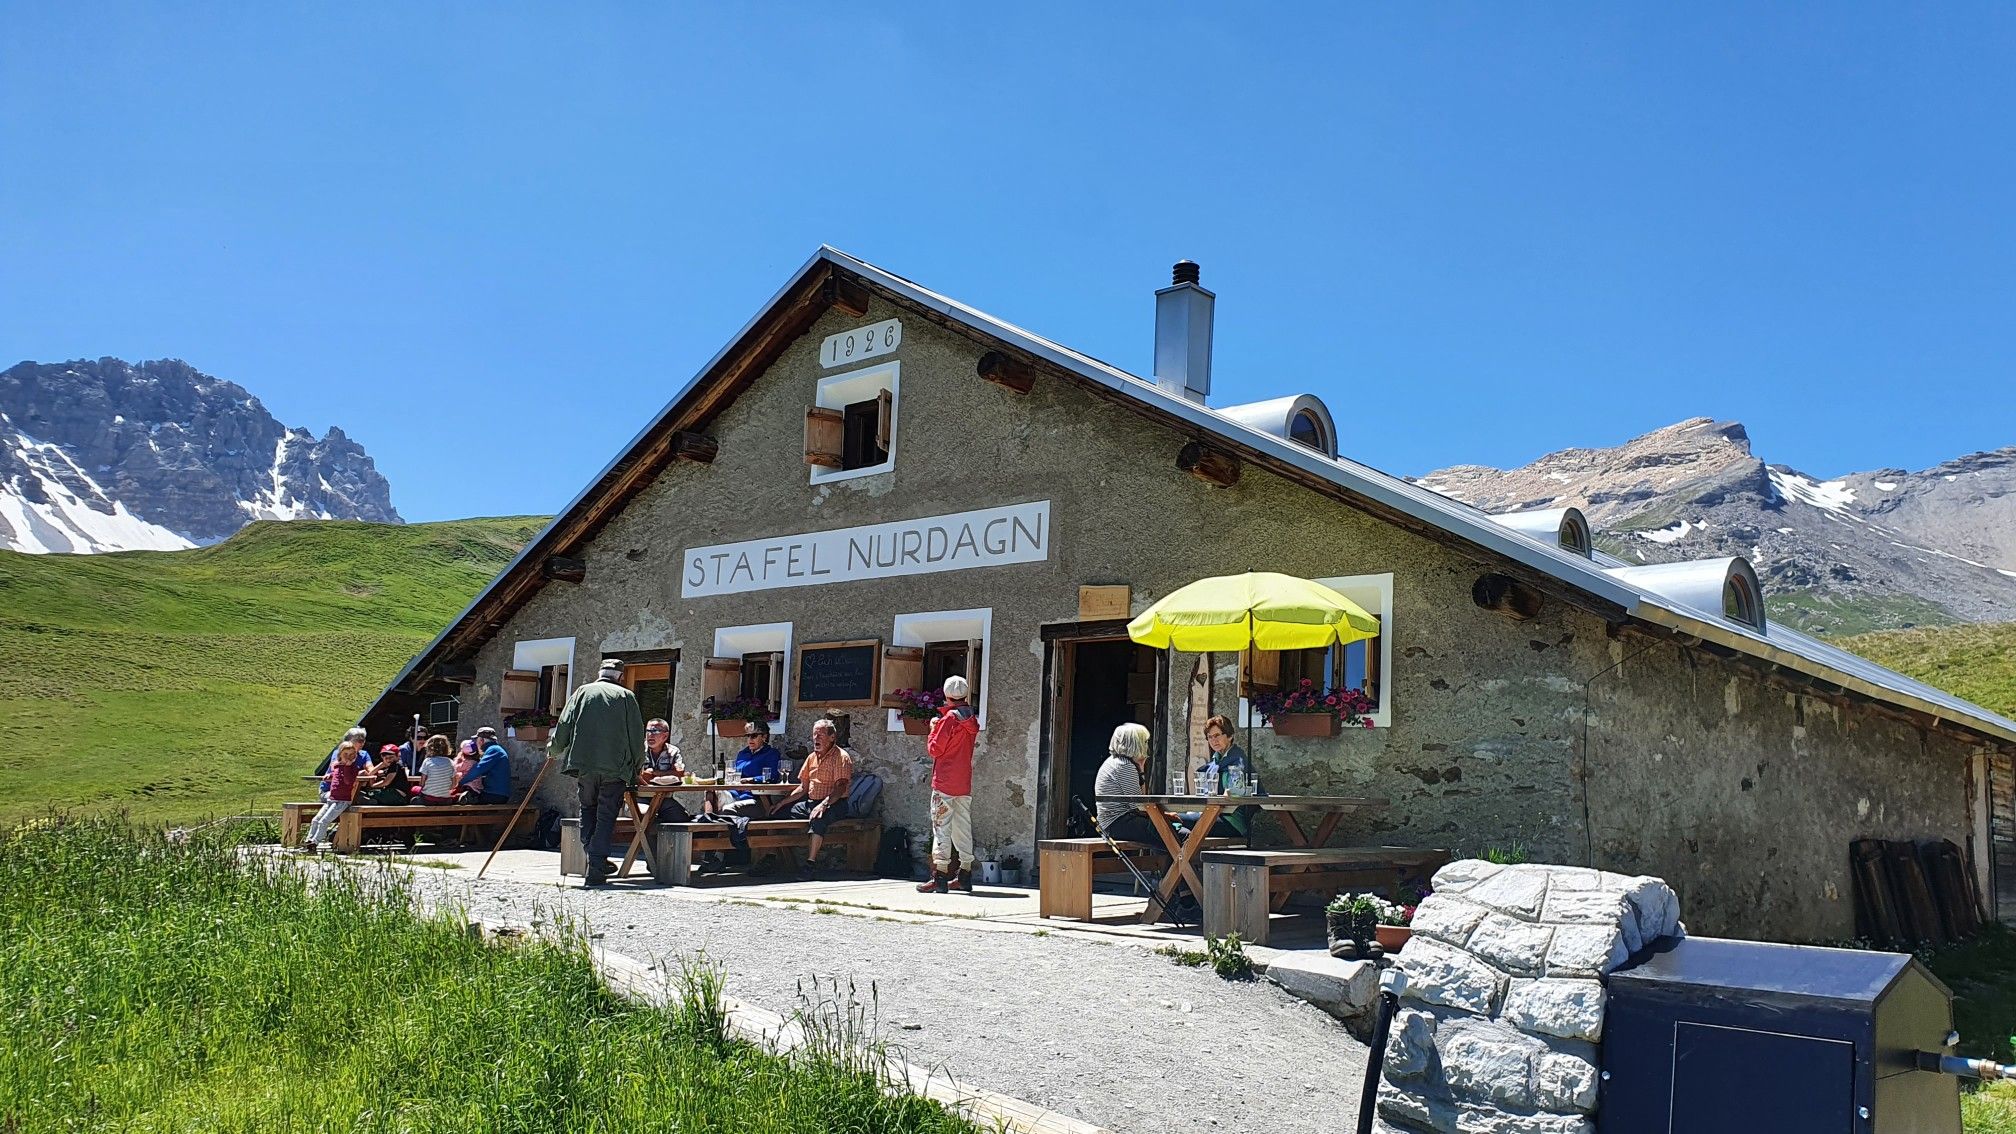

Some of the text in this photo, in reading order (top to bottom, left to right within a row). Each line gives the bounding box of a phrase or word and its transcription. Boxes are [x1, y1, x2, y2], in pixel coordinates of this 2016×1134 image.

[831, 325, 896, 362] 1926
[688, 512, 1042, 588] STAFEL NURDAGN
